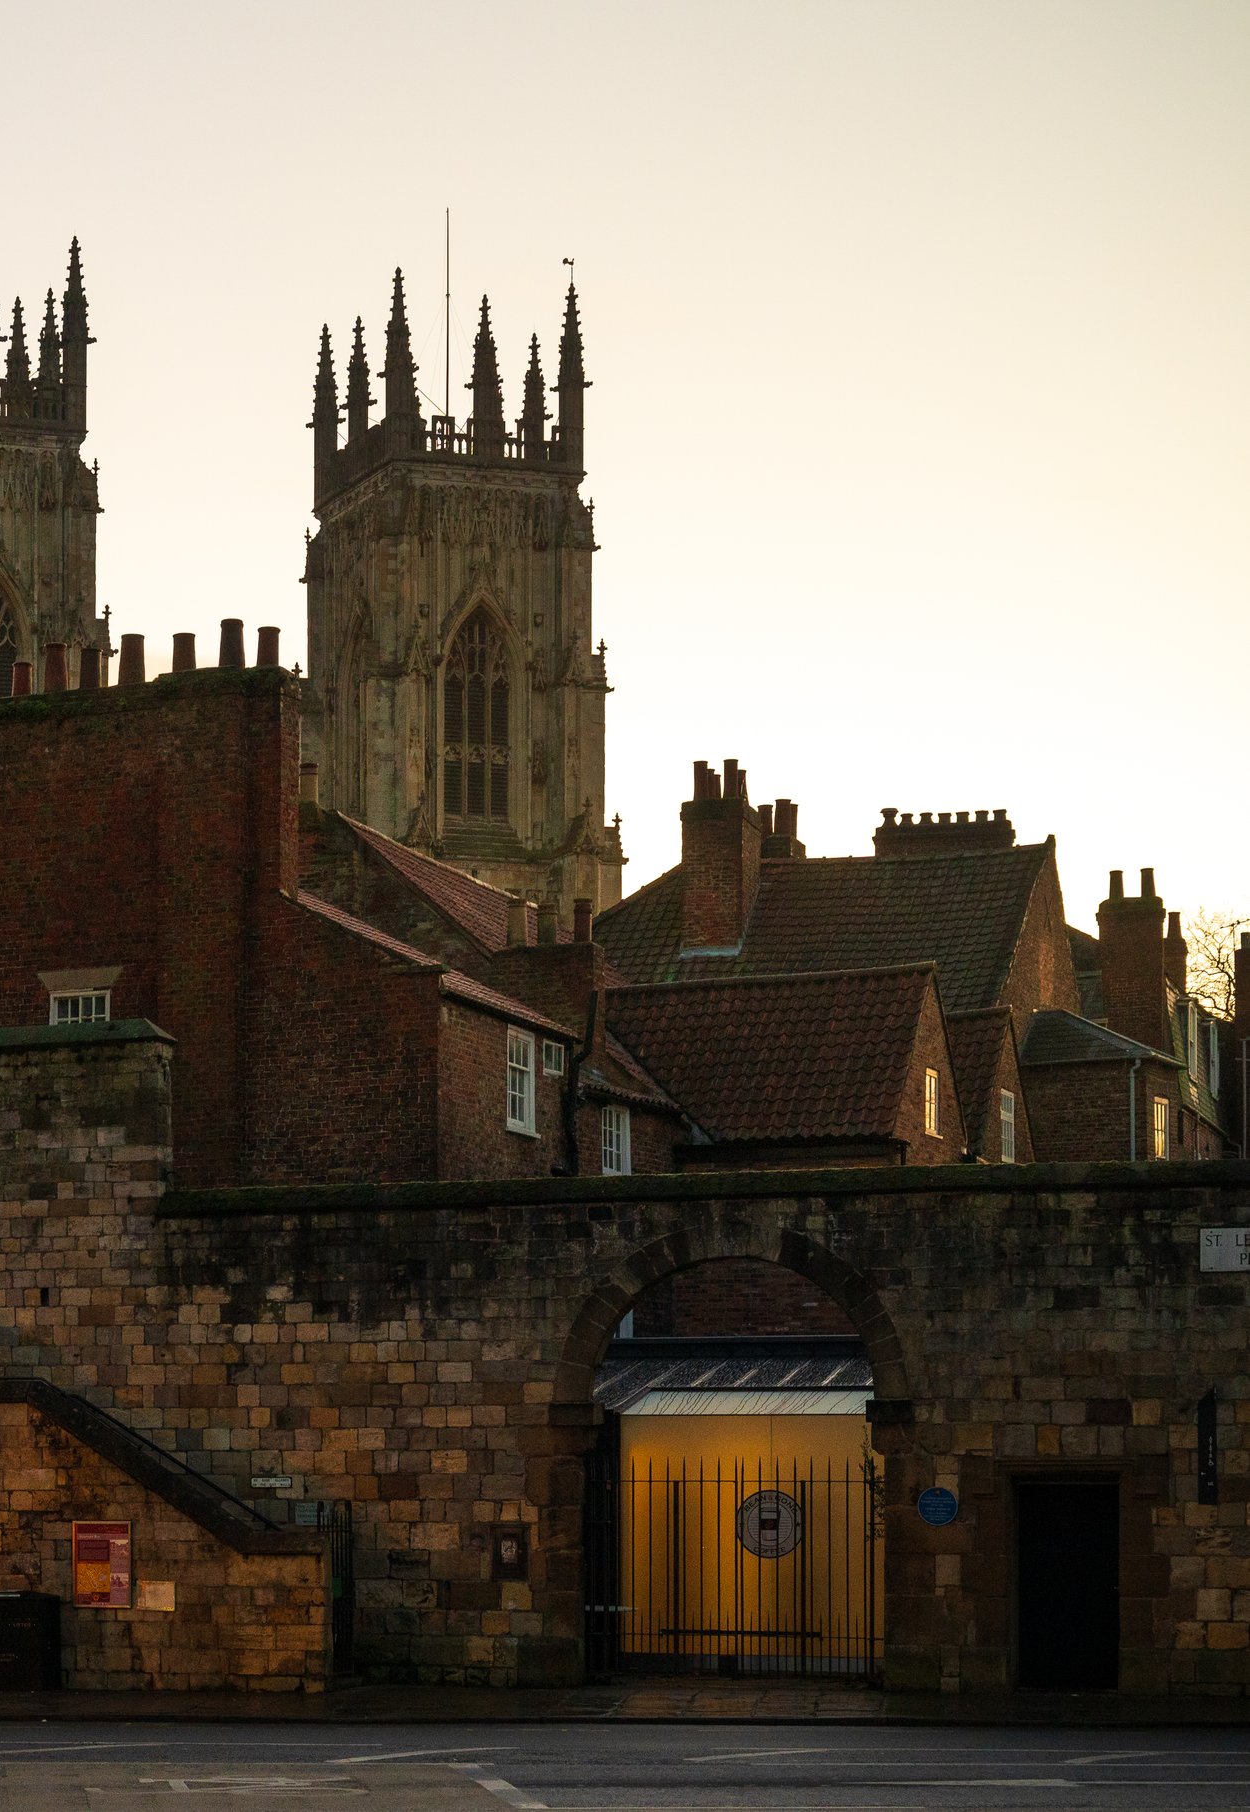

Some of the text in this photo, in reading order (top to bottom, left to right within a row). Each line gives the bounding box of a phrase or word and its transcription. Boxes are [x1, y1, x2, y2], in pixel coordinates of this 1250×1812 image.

[1205, 1234, 1222, 1247] ST.
[1240, 1252, 1250, 1265] P
[744, 1494, 767, 1512] BEAN
